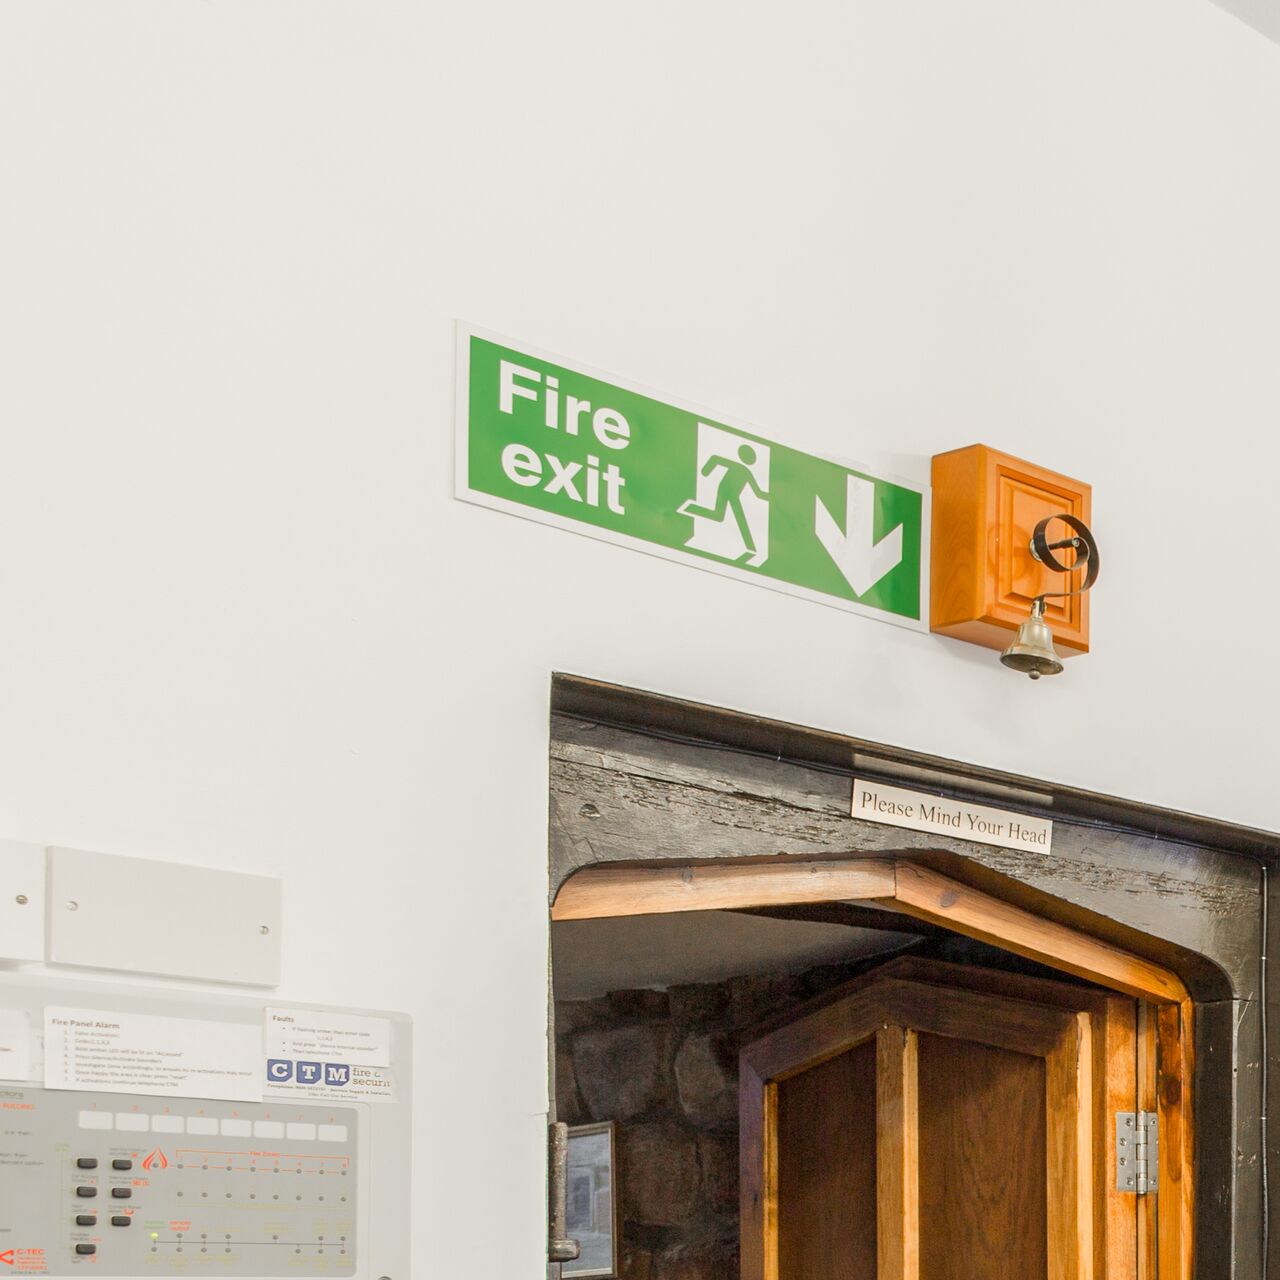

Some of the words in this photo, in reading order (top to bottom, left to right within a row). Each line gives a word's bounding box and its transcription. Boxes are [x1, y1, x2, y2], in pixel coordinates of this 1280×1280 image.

[499, 359, 630, 450] Fire
[502, 443, 625, 516] exit
[862, 791, 913, 817] Please
[920, 804, 961, 828] Mind
[967, 813, 1004, 836] Your
[1008, 822, 1047, 845] Head
[52, 1018, 68, 1026] Fire
[70, 1020, 94, 1028] Panel
[96, 1021, 120, 1029] Alarm
[269, 1060, 348, 1084] CTM
[352, 1068, 371, 1077] fire
[17, 1248, 45, 1256] C-TEC
